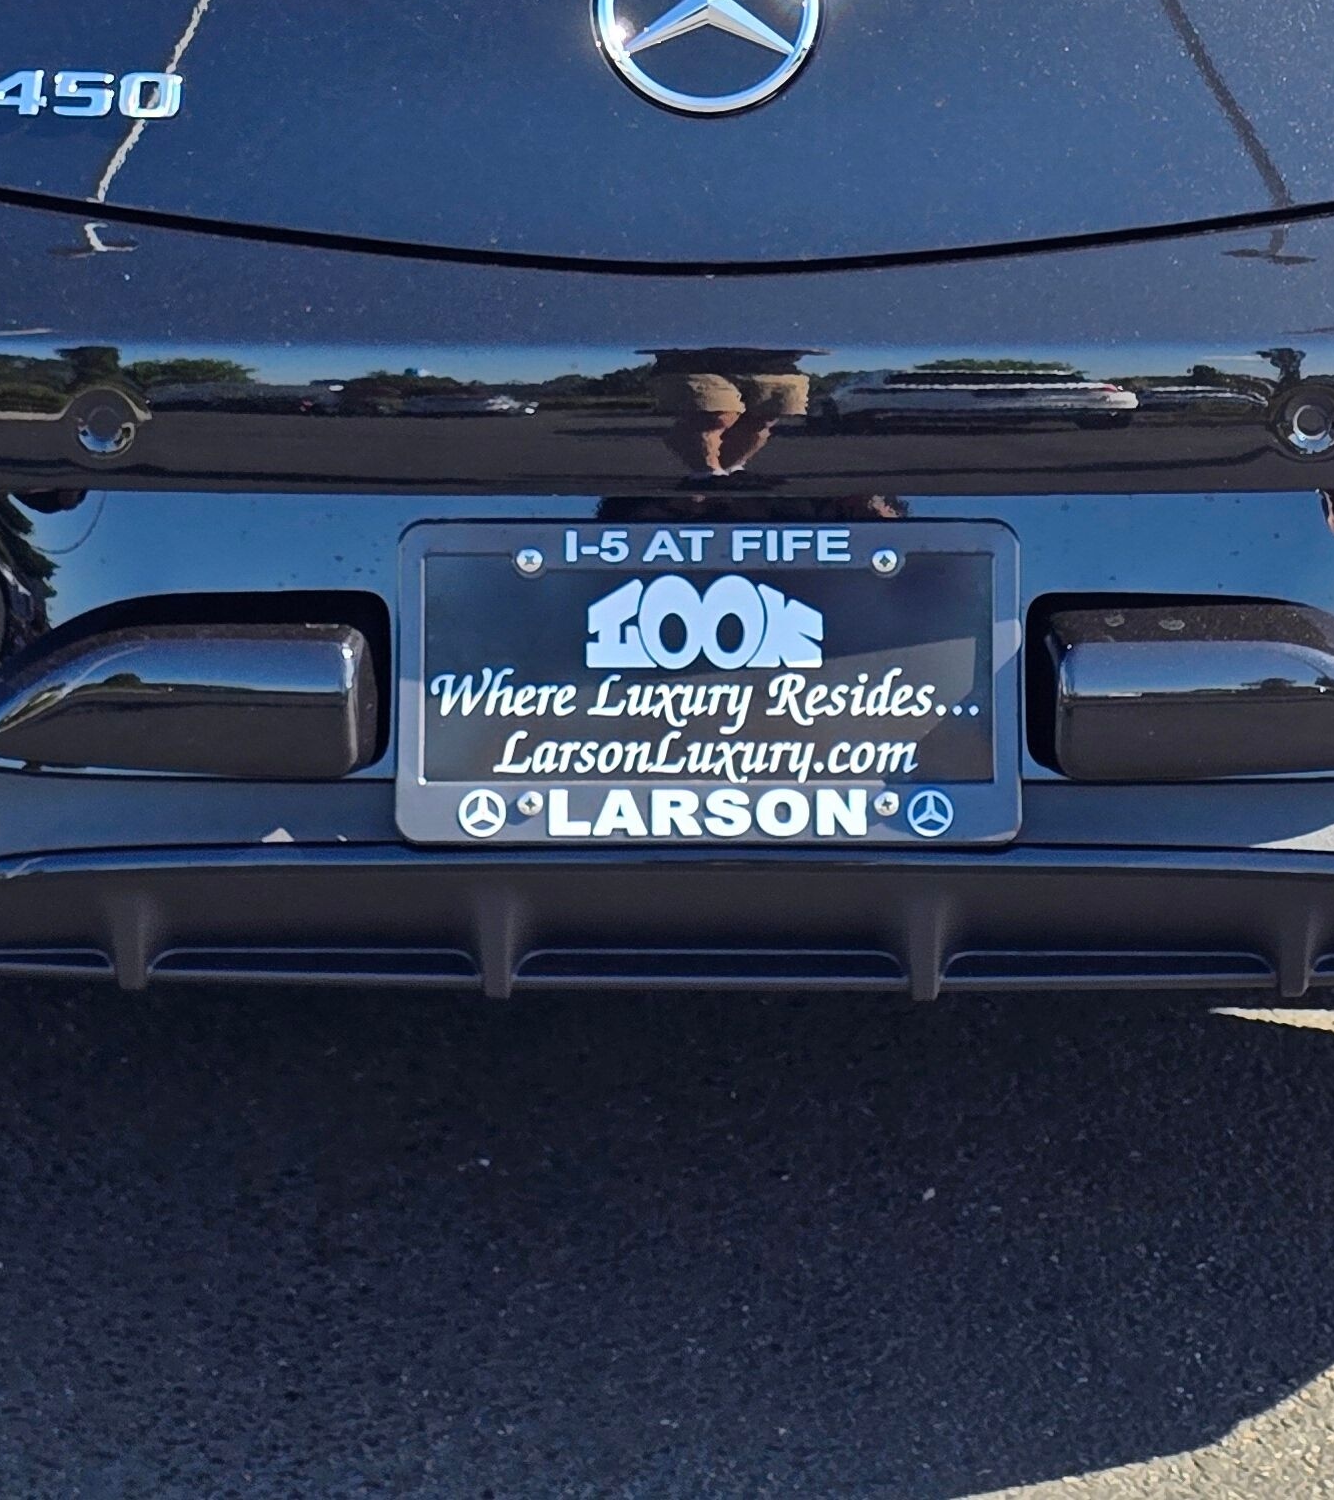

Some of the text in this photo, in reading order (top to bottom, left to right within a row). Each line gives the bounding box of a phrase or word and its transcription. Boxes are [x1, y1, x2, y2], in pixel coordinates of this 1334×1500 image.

[566, 530, 851, 562] I-5 AT FIFE
[431, 668, 979, 733] Where Luxury Resides...
[493, 730, 917, 783] LarsonLuxury.com
[548, 789, 867, 836] LARSON
